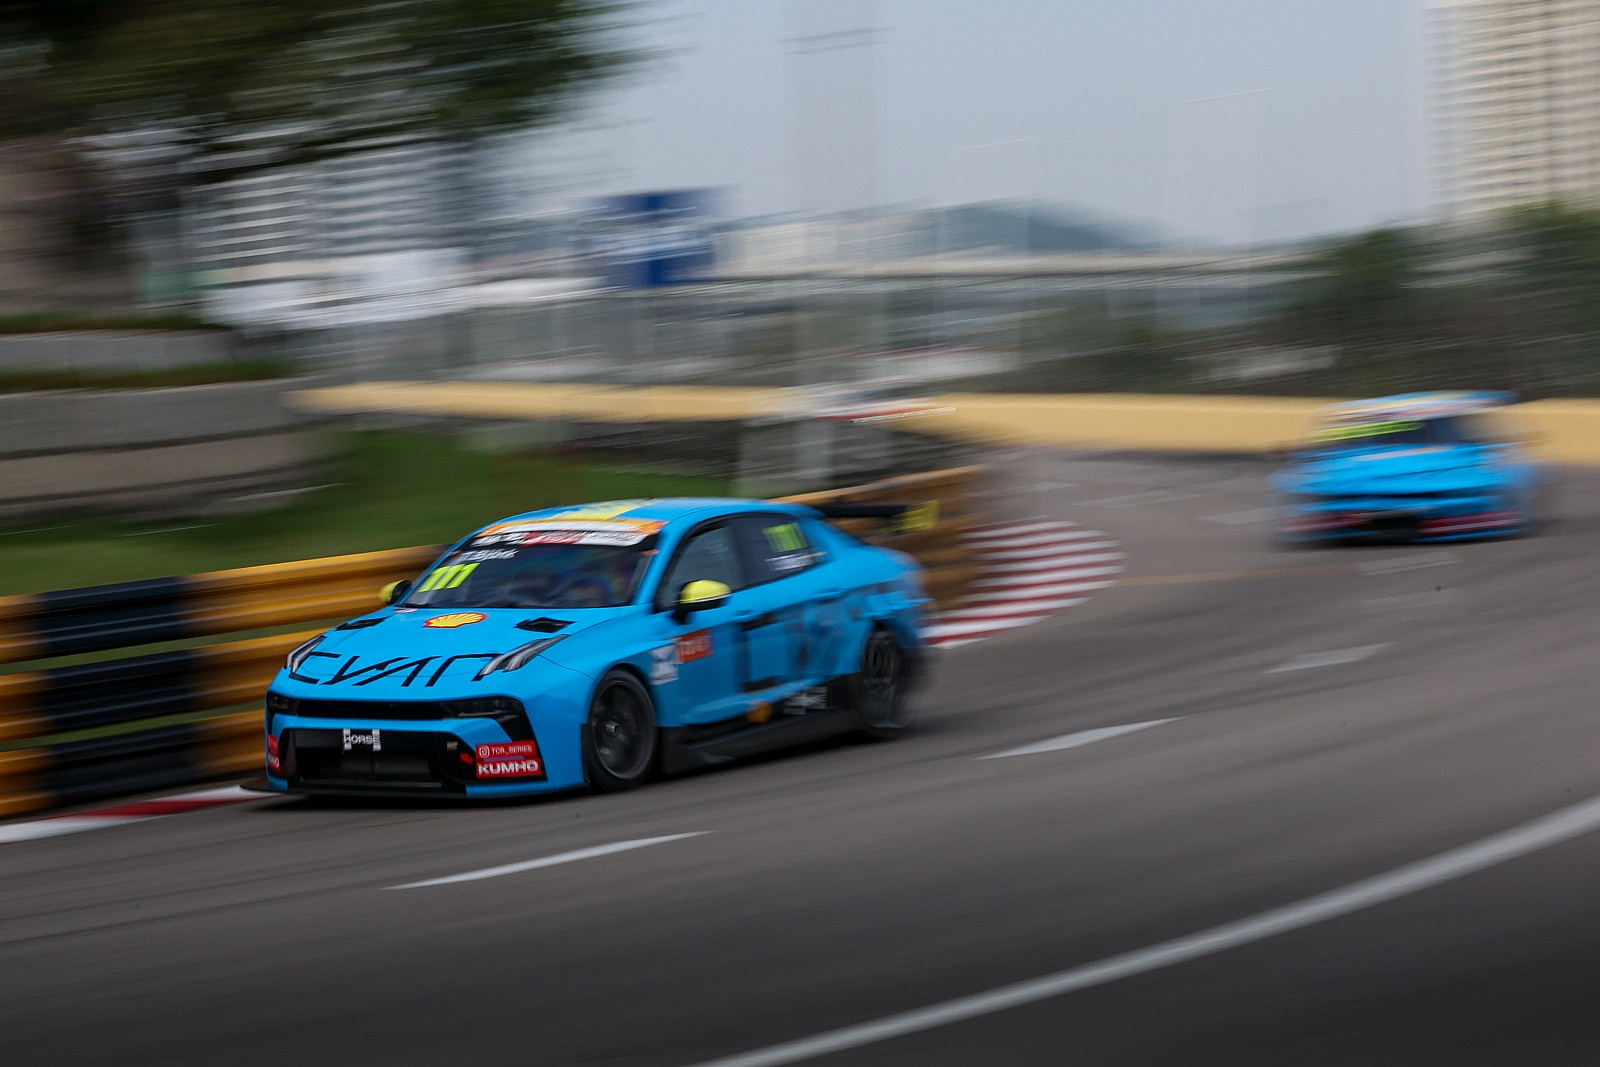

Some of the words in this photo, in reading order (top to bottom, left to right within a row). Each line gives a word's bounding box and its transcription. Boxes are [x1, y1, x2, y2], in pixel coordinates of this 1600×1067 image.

[418, 562, 481, 593] 111
[342, 730, 381, 749] HORSE
[491, 745, 533, 755] TCR_SERIES
[478, 760, 539, 775] KUMHO
